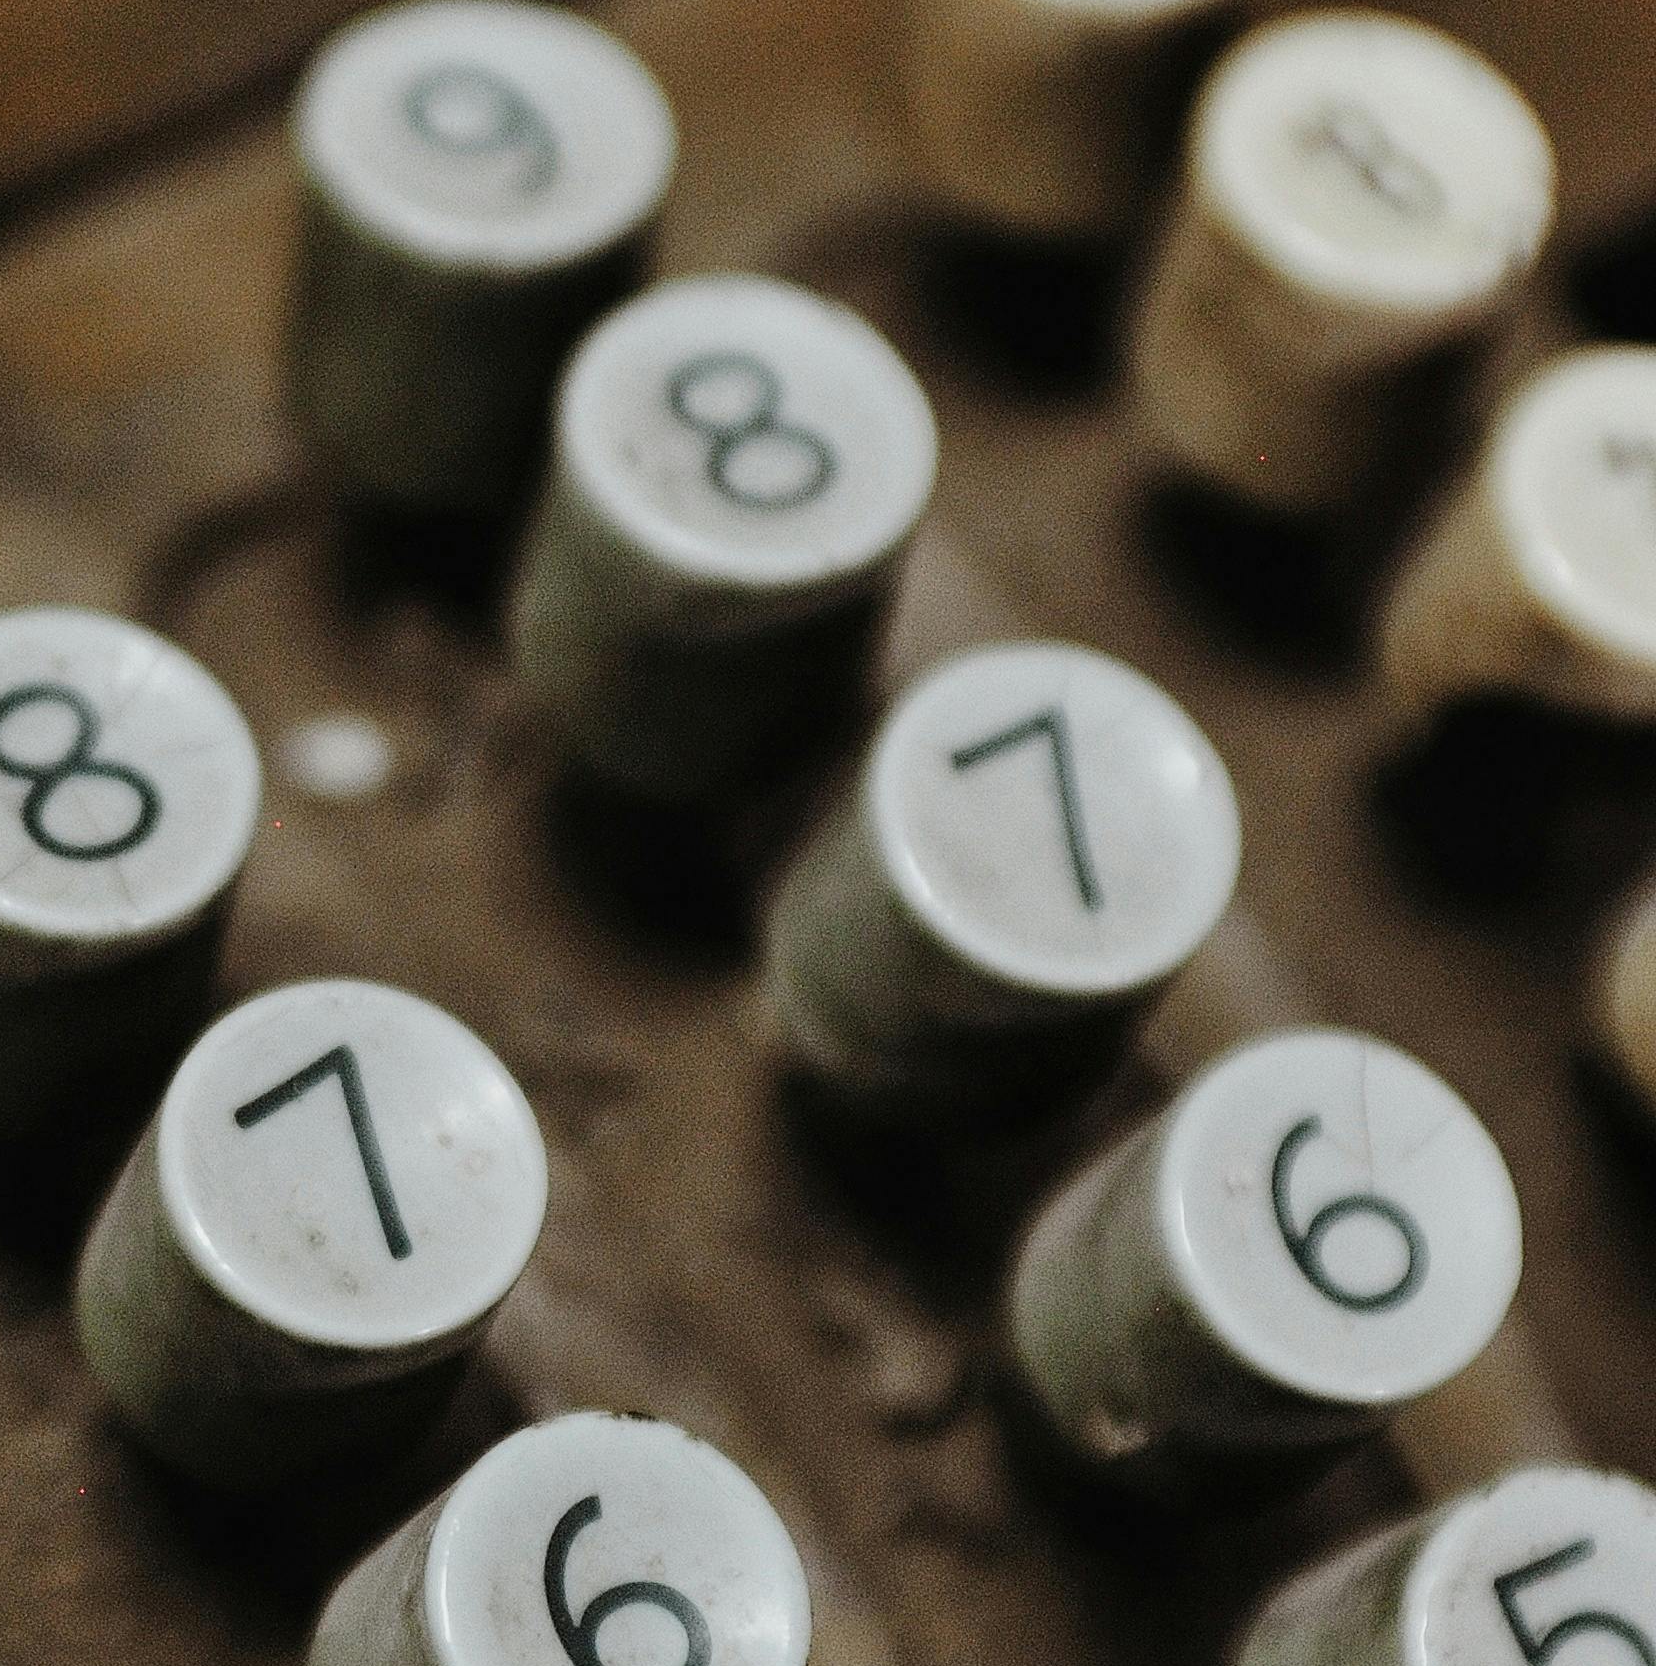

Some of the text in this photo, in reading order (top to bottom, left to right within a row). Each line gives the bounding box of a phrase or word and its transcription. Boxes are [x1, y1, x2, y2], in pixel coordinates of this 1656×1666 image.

[400, 72, 563, 205] 9
[661, 358, 837, 515] 8
[950, 712, 1100, 909] 7
[233, 1047, 410, 1259] 7
[1267, 1118, 1423, 1314] 6
